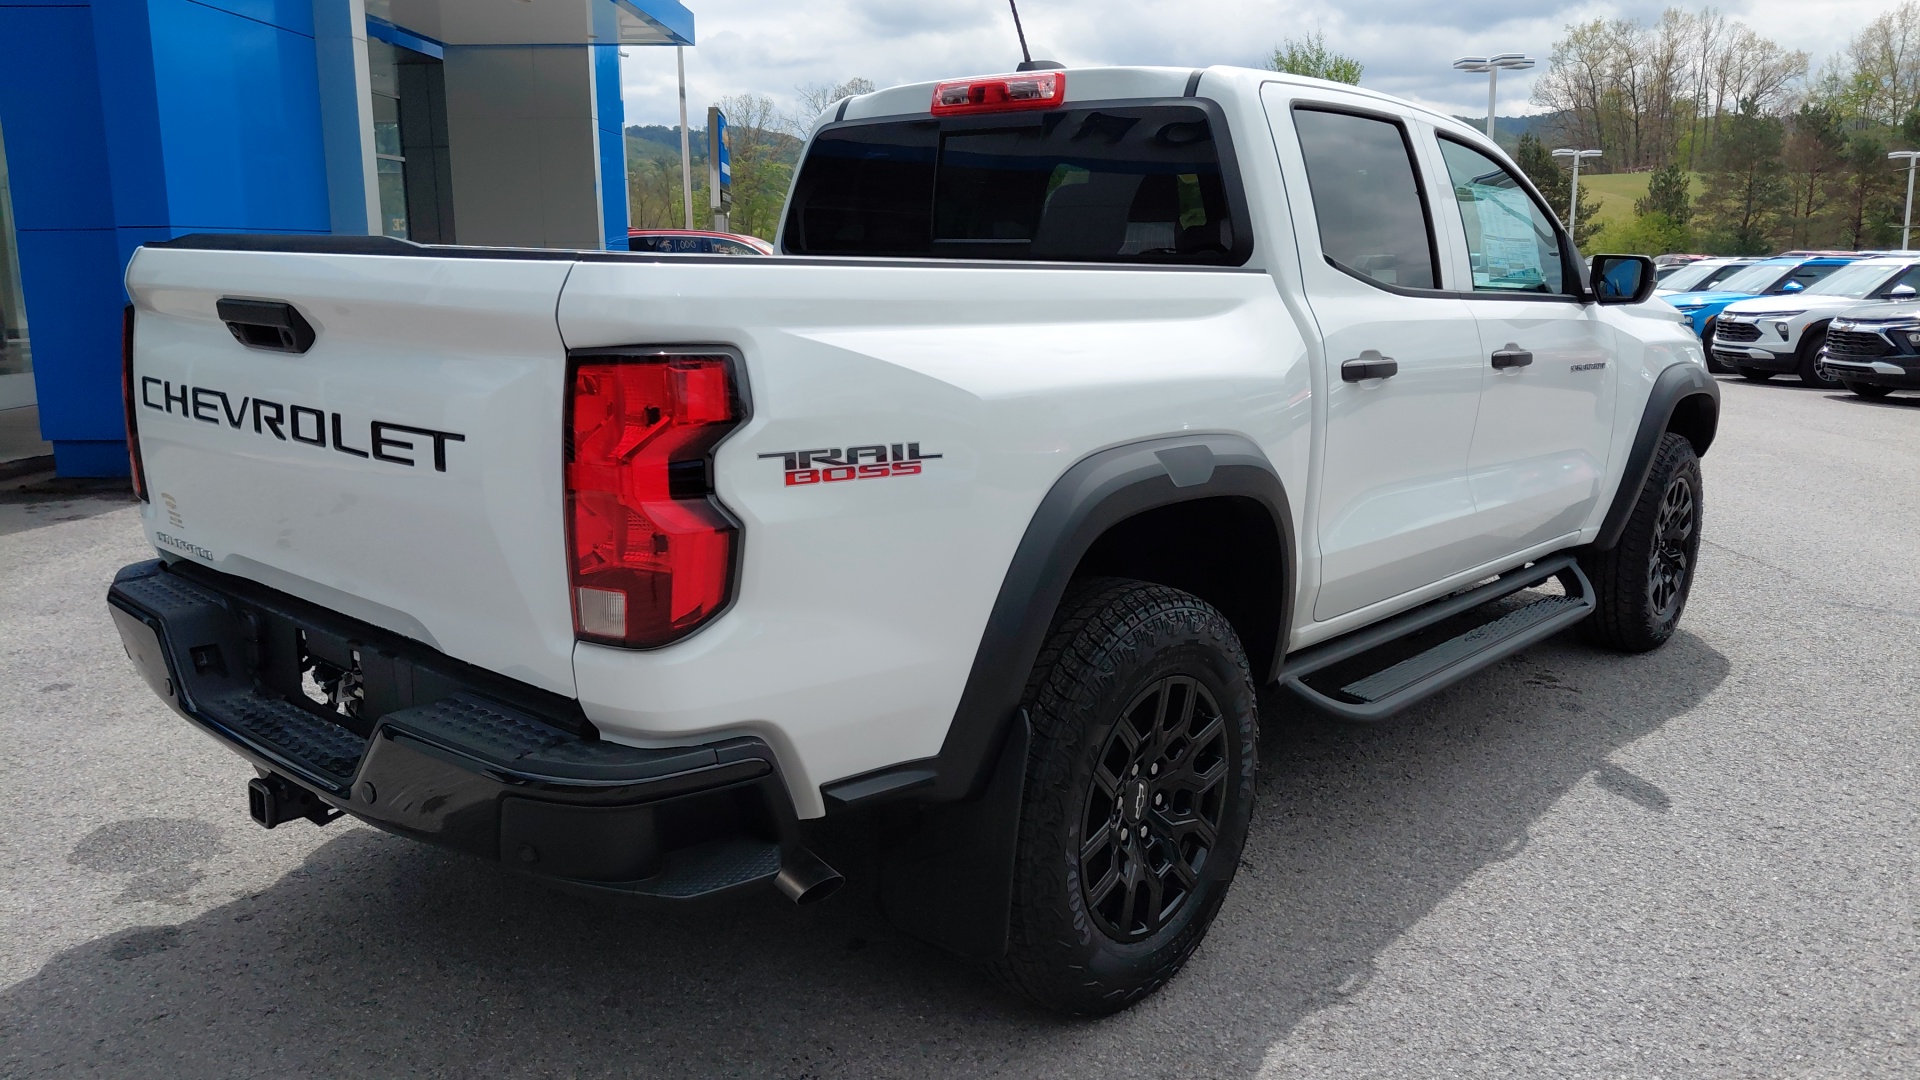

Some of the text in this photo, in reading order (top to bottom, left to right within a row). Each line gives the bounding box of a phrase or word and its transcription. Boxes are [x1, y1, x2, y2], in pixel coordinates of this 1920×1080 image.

[142, 375, 466, 473] CHEVROLET
[757, 441, 943, 471] TRAIL
[784, 460, 922, 487] BOSS
